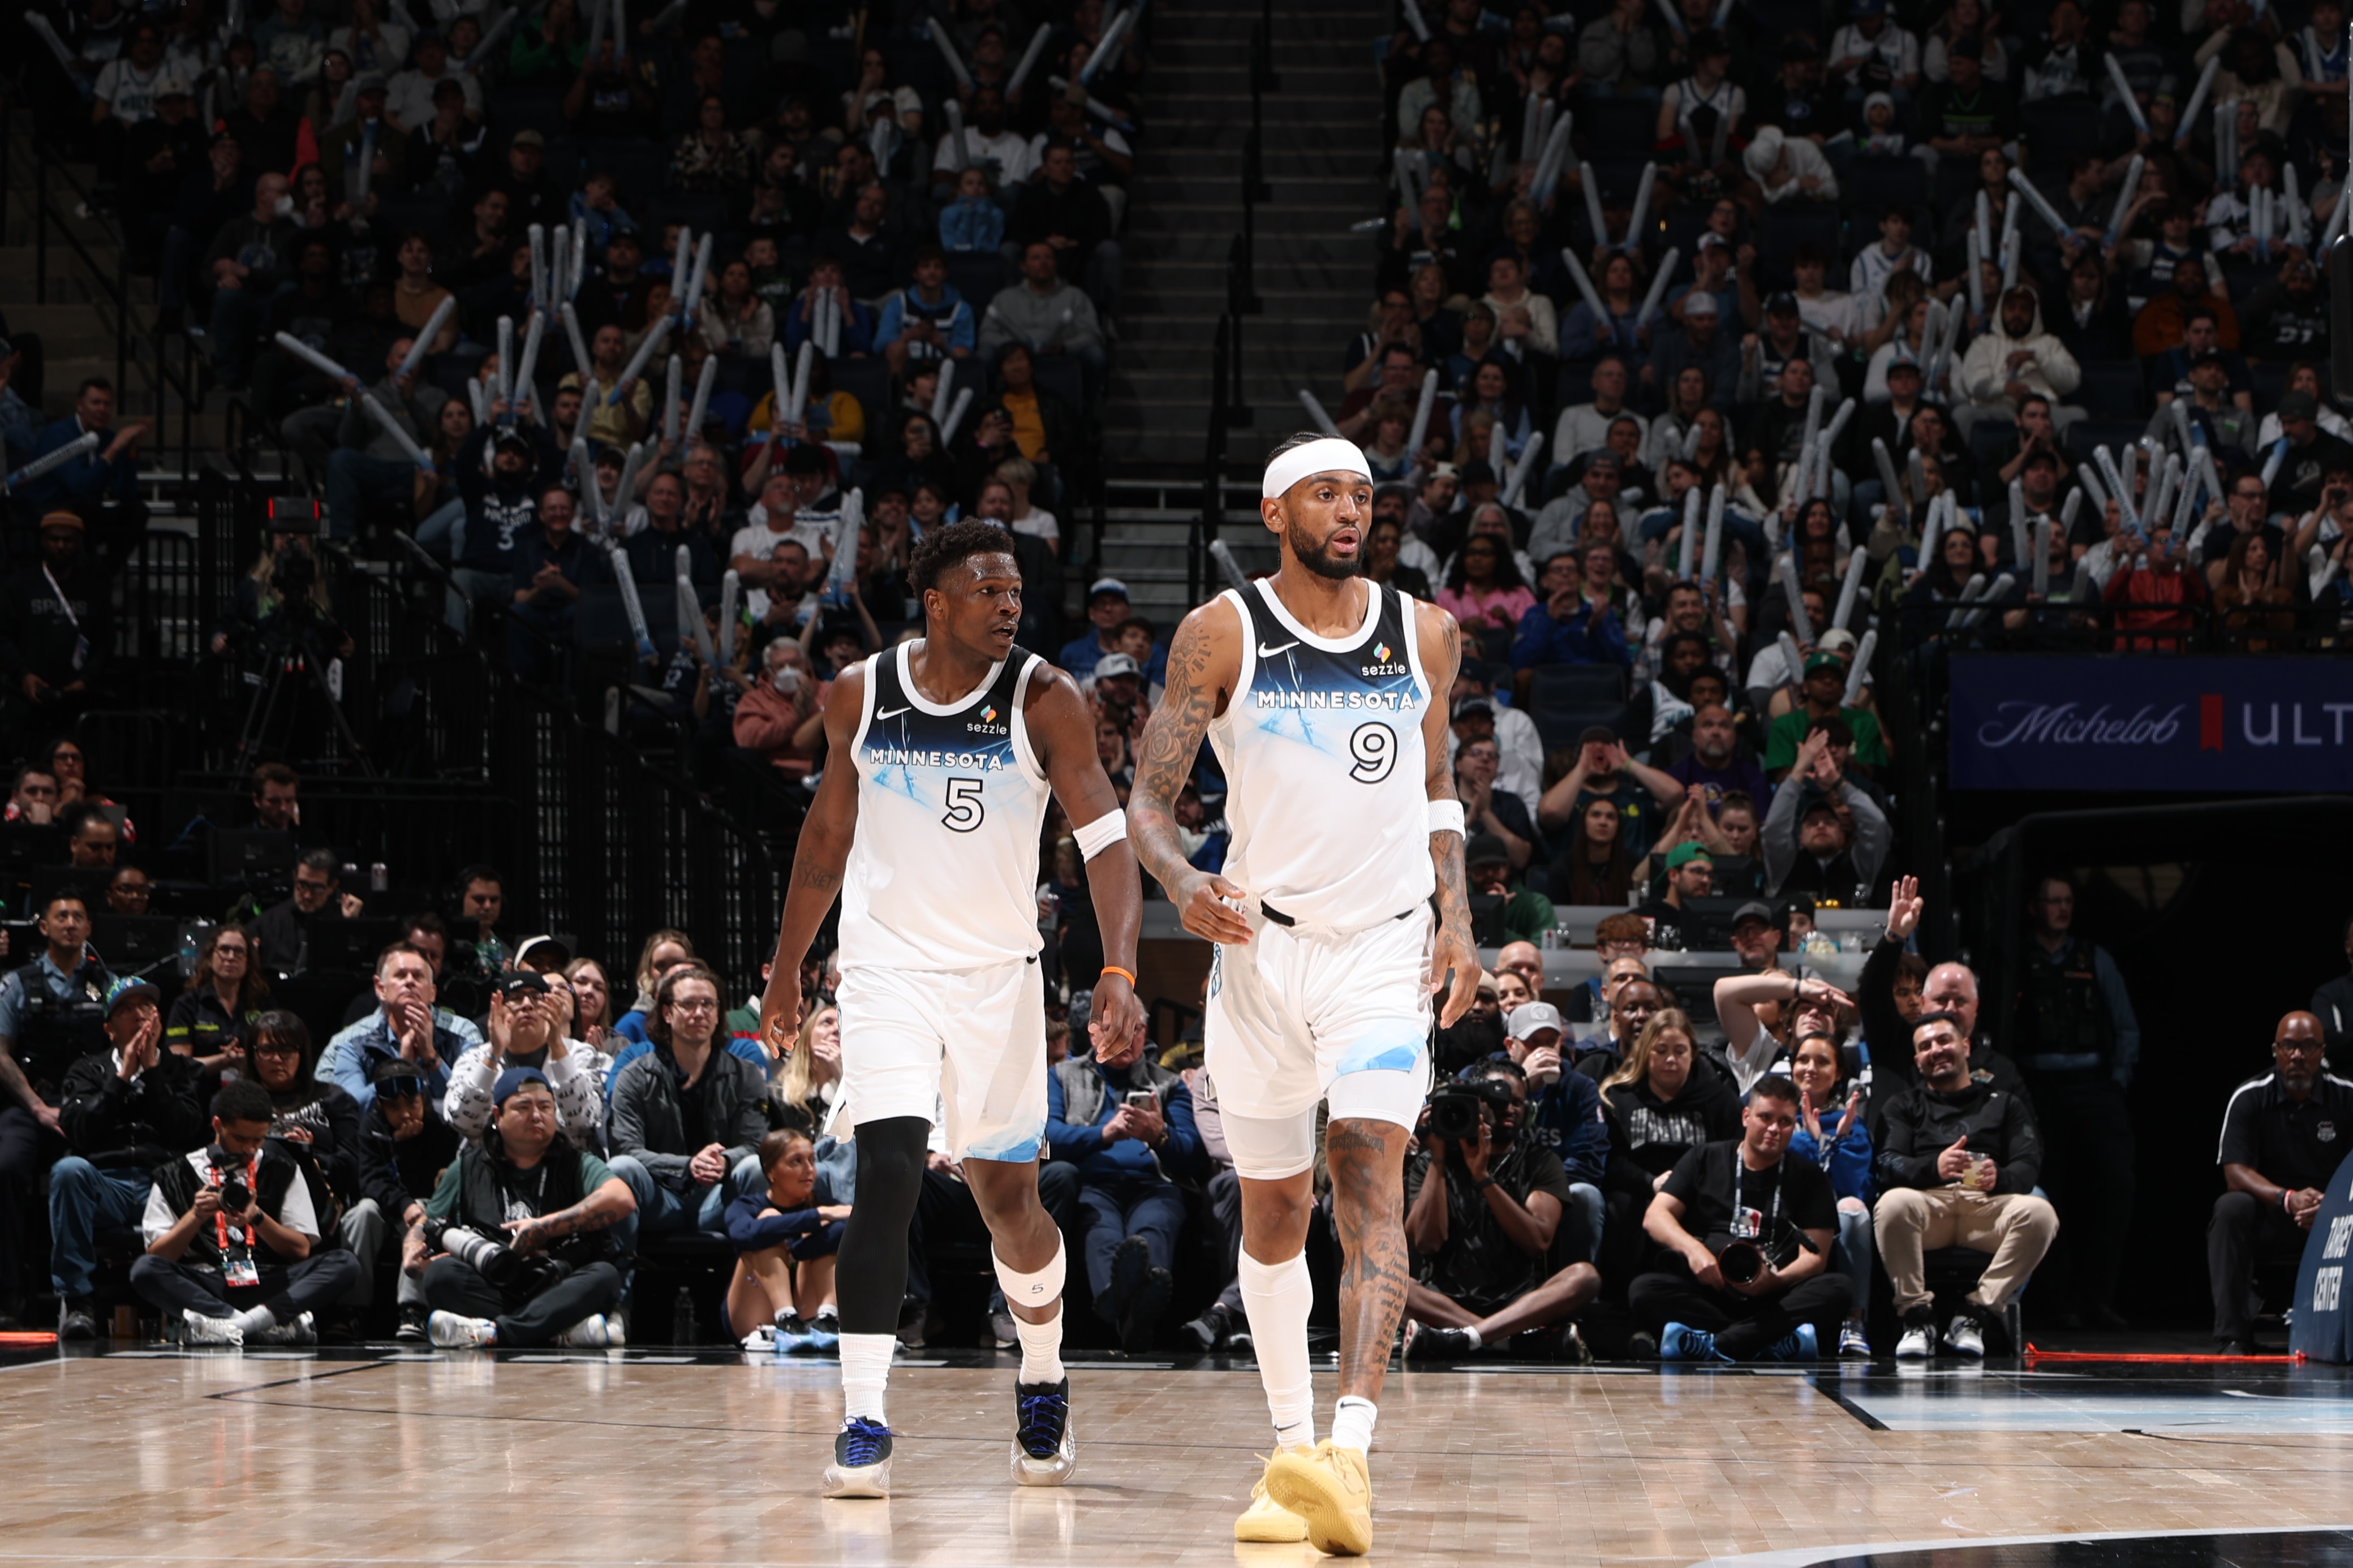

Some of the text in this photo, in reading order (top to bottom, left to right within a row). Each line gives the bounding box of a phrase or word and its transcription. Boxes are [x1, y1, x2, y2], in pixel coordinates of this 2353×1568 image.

[497, 525, 514, 550] 3
[1362, 661, 1406, 677] sezzle
[1257, 690, 1416, 710] MINNESOTA
[967, 723, 1007, 735] sezzle
[1977, 701, 2353, 748] Michelob ULT
[870, 748, 1004, 770] MINNESOTA
[1349, 721, 1398, 785] 9
[941, 777, 984, 833] 5
[1528, 1127, 1562, 1147] VES
[2322, 1214, 2353, 1260] TARGET
[1031, 1283, 1043, 1294] 5
[2313, 1265, 2343, 1313] CENTER
